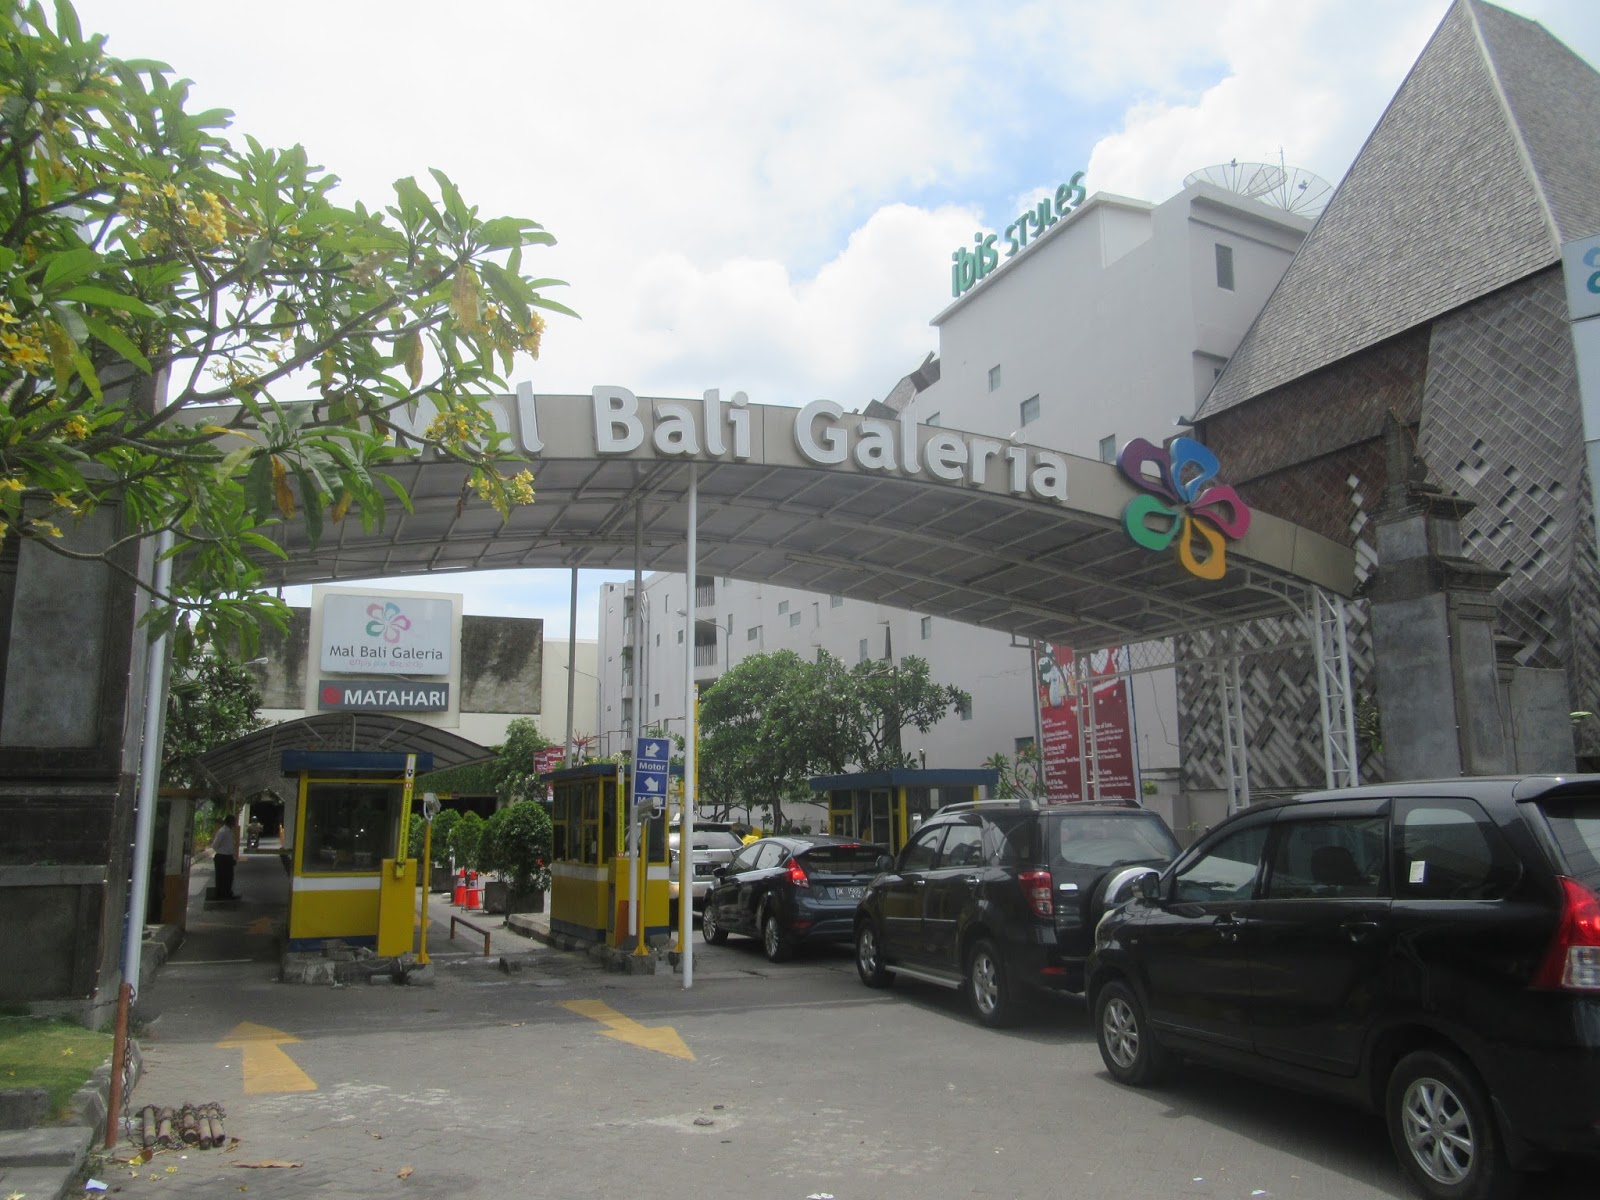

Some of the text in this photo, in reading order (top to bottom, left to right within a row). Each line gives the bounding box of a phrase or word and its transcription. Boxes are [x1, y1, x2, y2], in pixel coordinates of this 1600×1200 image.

[951, 231, 999, 298] ibis
[591, 384, 751, 460] Bali
[793, 398, 1069, 502] Galeria
[329, 645, 444, 660] Mal Bali Galeria
[344, 689, 446, 706] MATAHARI
[638, 761, 666, 771] Motor
